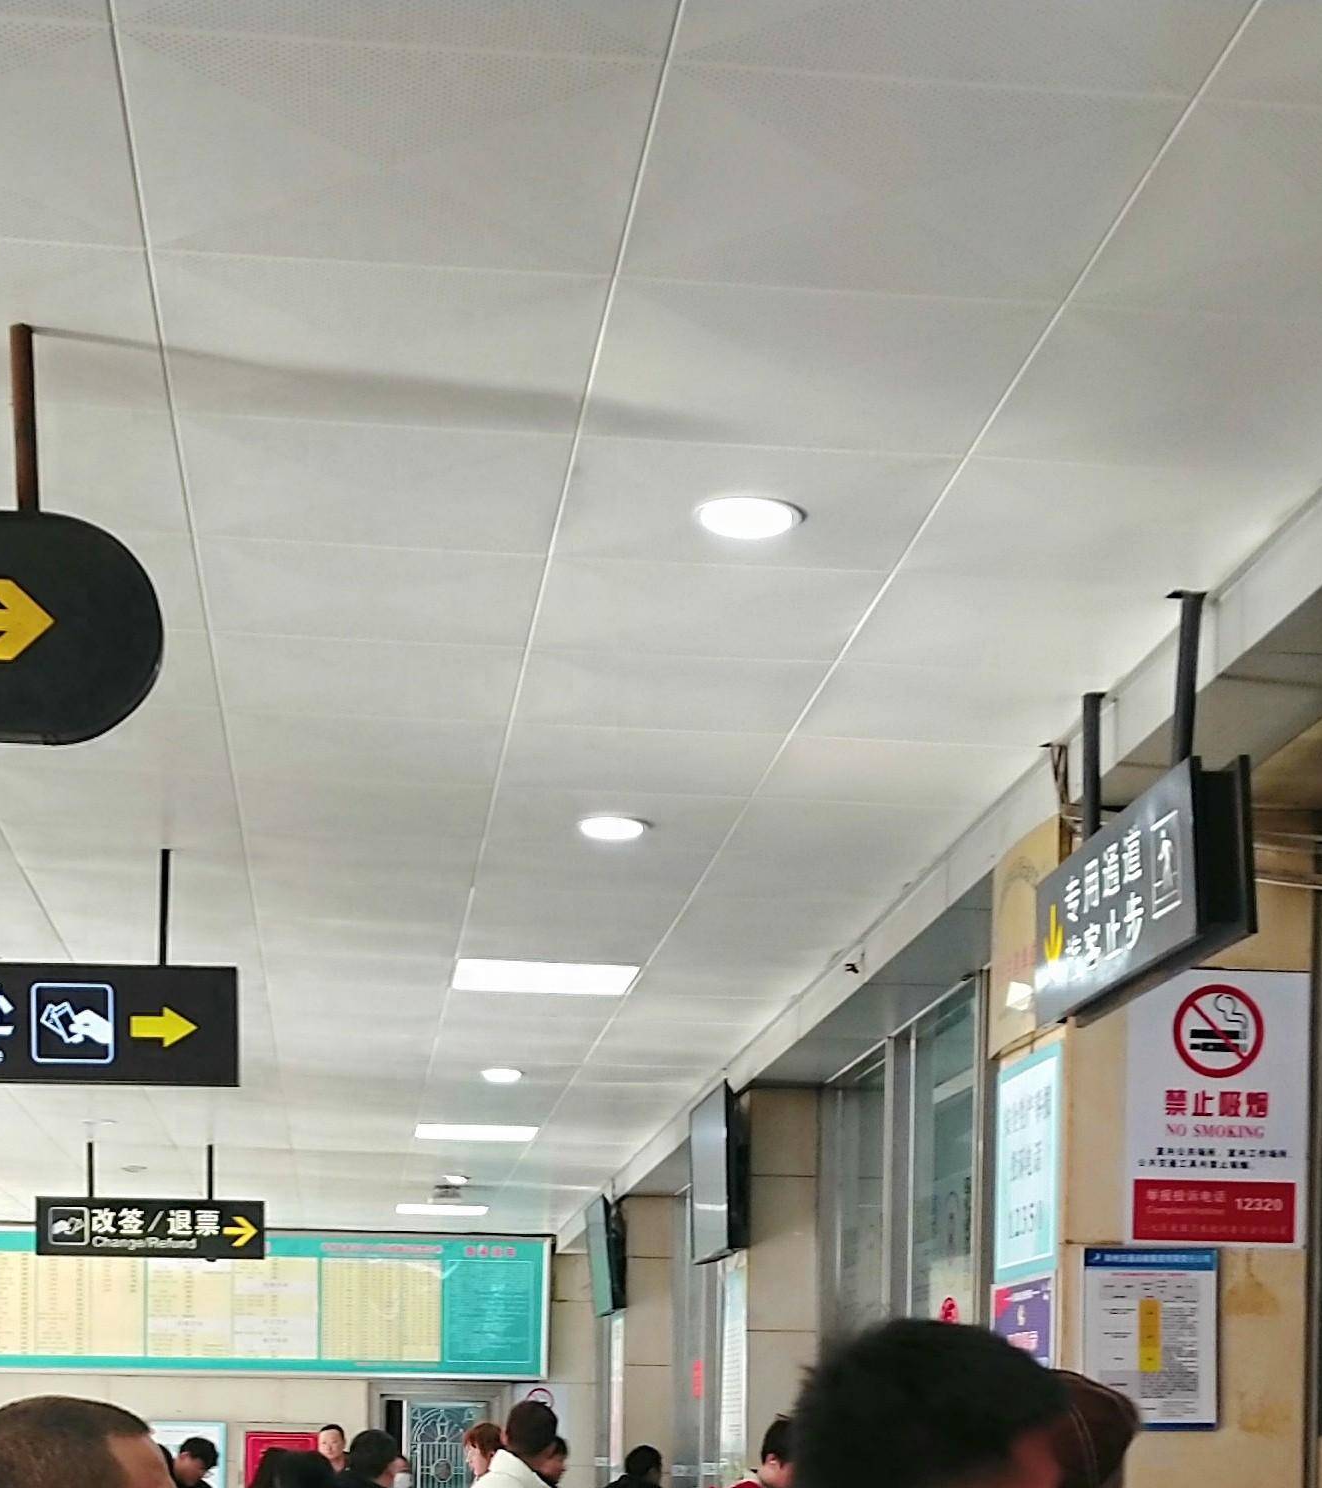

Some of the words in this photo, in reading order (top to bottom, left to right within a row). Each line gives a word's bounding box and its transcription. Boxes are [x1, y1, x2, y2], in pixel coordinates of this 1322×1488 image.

[1165, 1089, 1269, 1118] 禁止吸烟
[1165, 1123, 1187, 1137] NO
[1192, 1124, 1265, 1139] SMOKING
